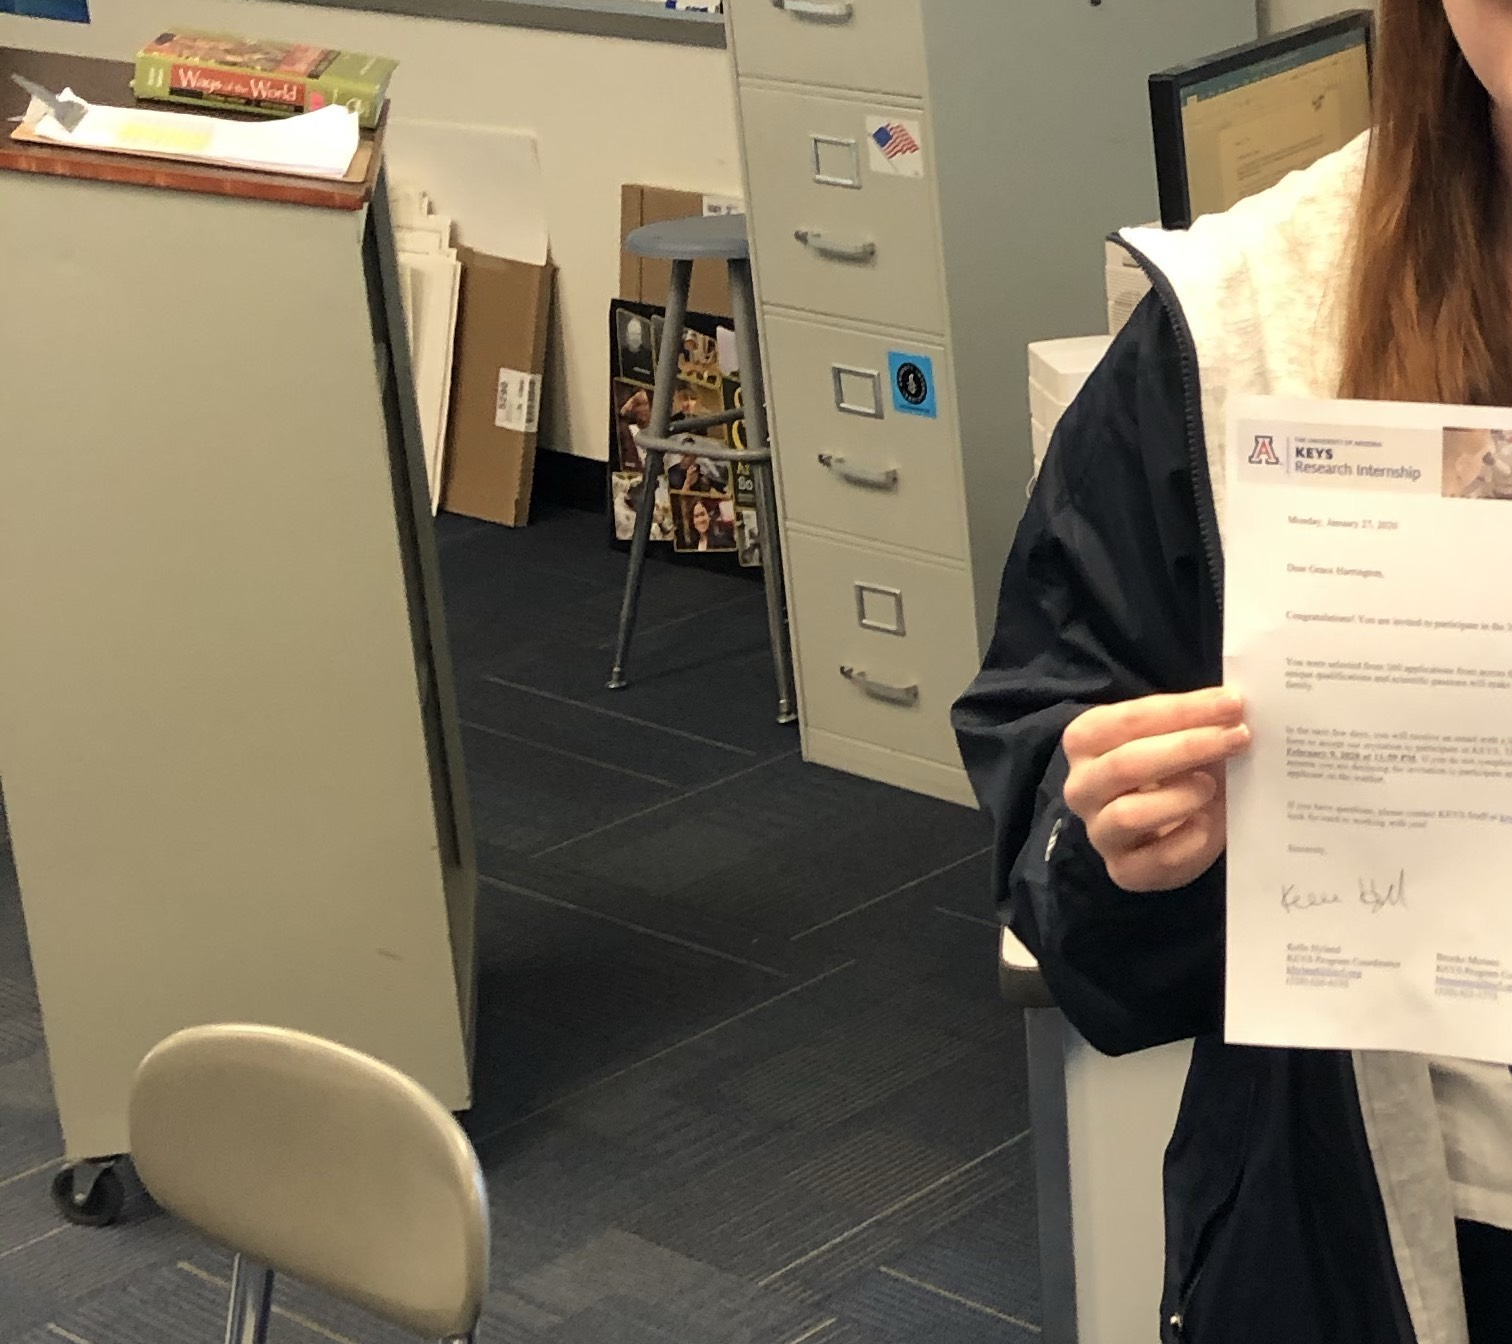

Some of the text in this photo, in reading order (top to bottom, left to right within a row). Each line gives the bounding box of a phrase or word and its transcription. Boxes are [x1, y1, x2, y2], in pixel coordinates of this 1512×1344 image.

[178, 68, 223, 93] Ways
[250, 79, 297, 102] World
[1295, 446, 1334, 460] KEYS
[1295, 460, 1422, 482] Research Internship
